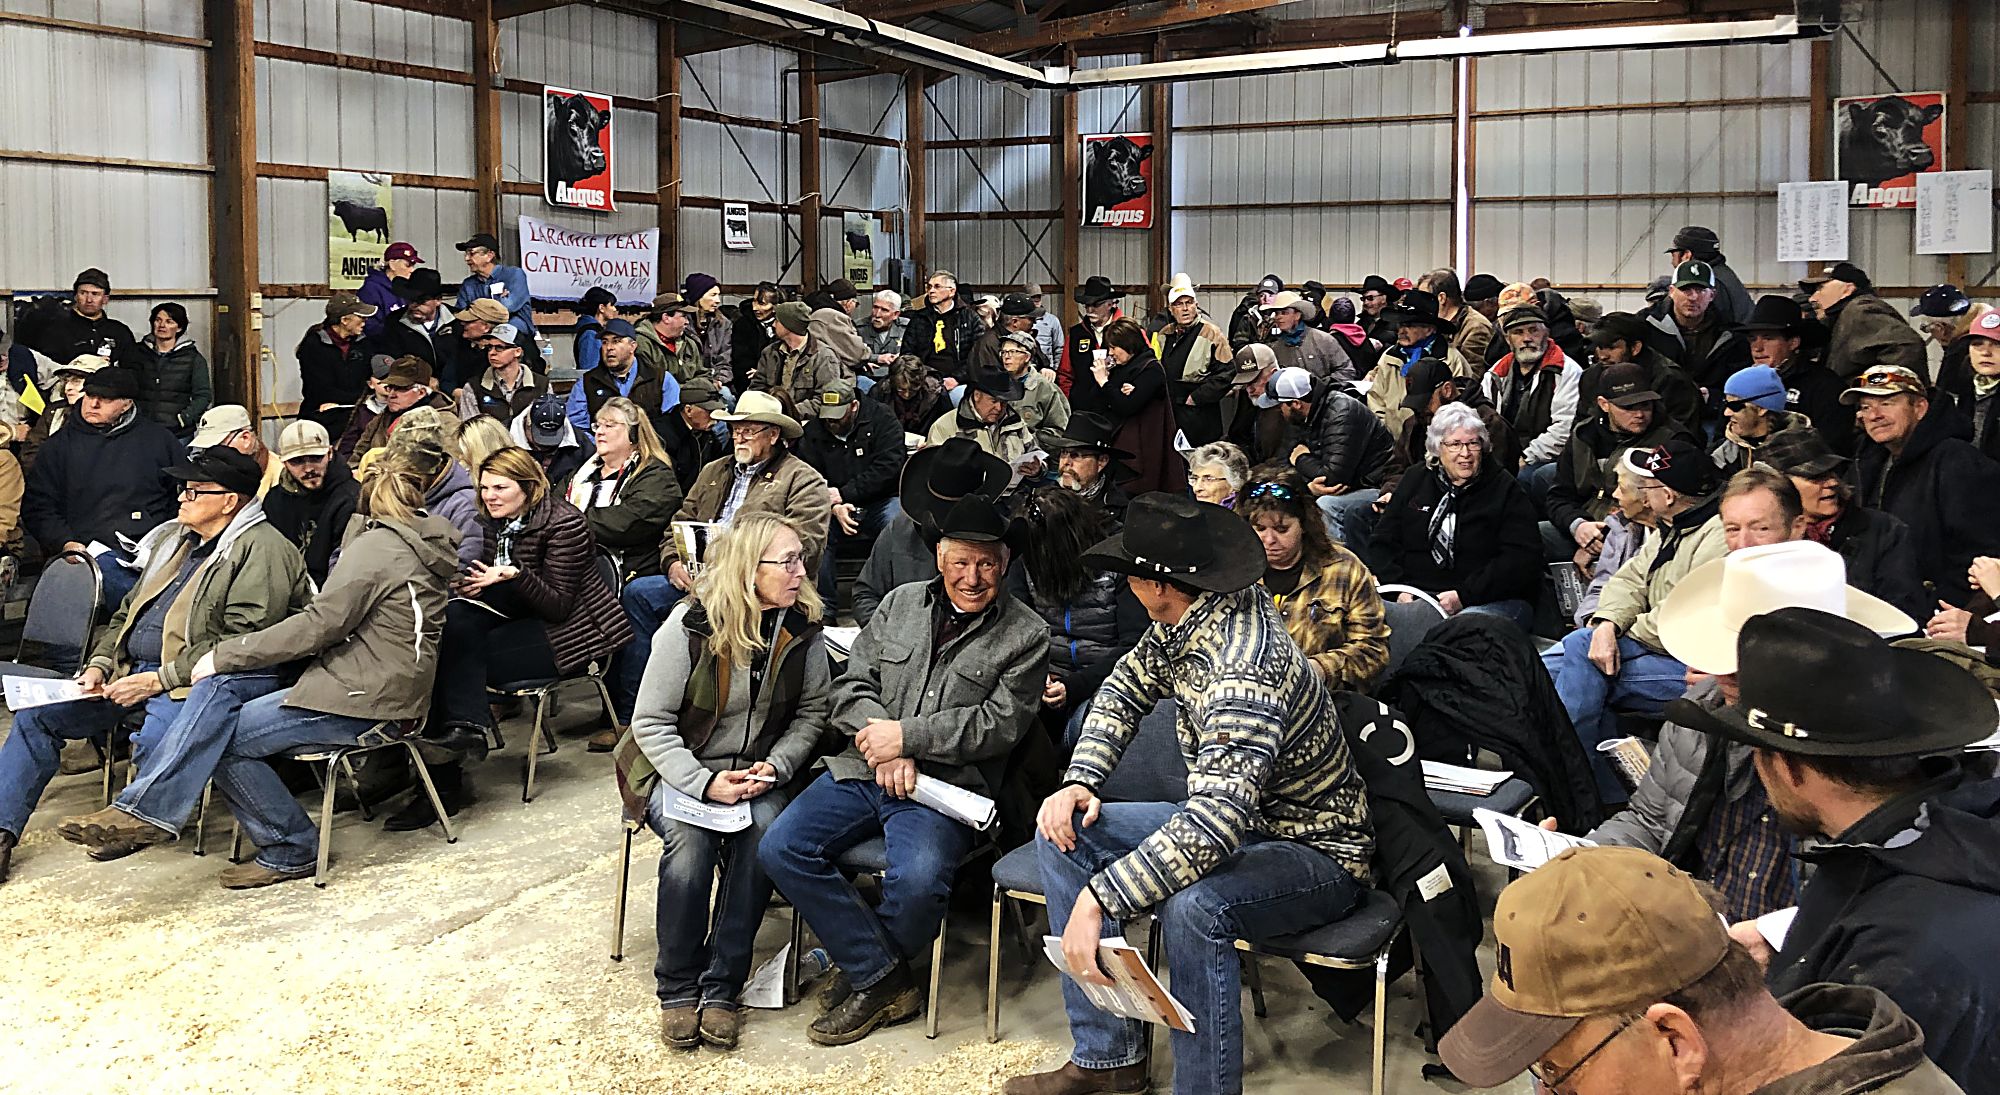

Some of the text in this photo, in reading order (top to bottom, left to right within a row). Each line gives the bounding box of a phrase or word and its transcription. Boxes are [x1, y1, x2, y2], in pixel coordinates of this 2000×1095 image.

[556, 181, 605, 207] Angus
[1851, 183, 1916, 207] Angu
[726, 207, 746, 215] ANGUS
[1091, 206, 1144, 226] Angus
[605, 233, 649, 249] PEAK
[850, 268, 868, 280] ANGUS
